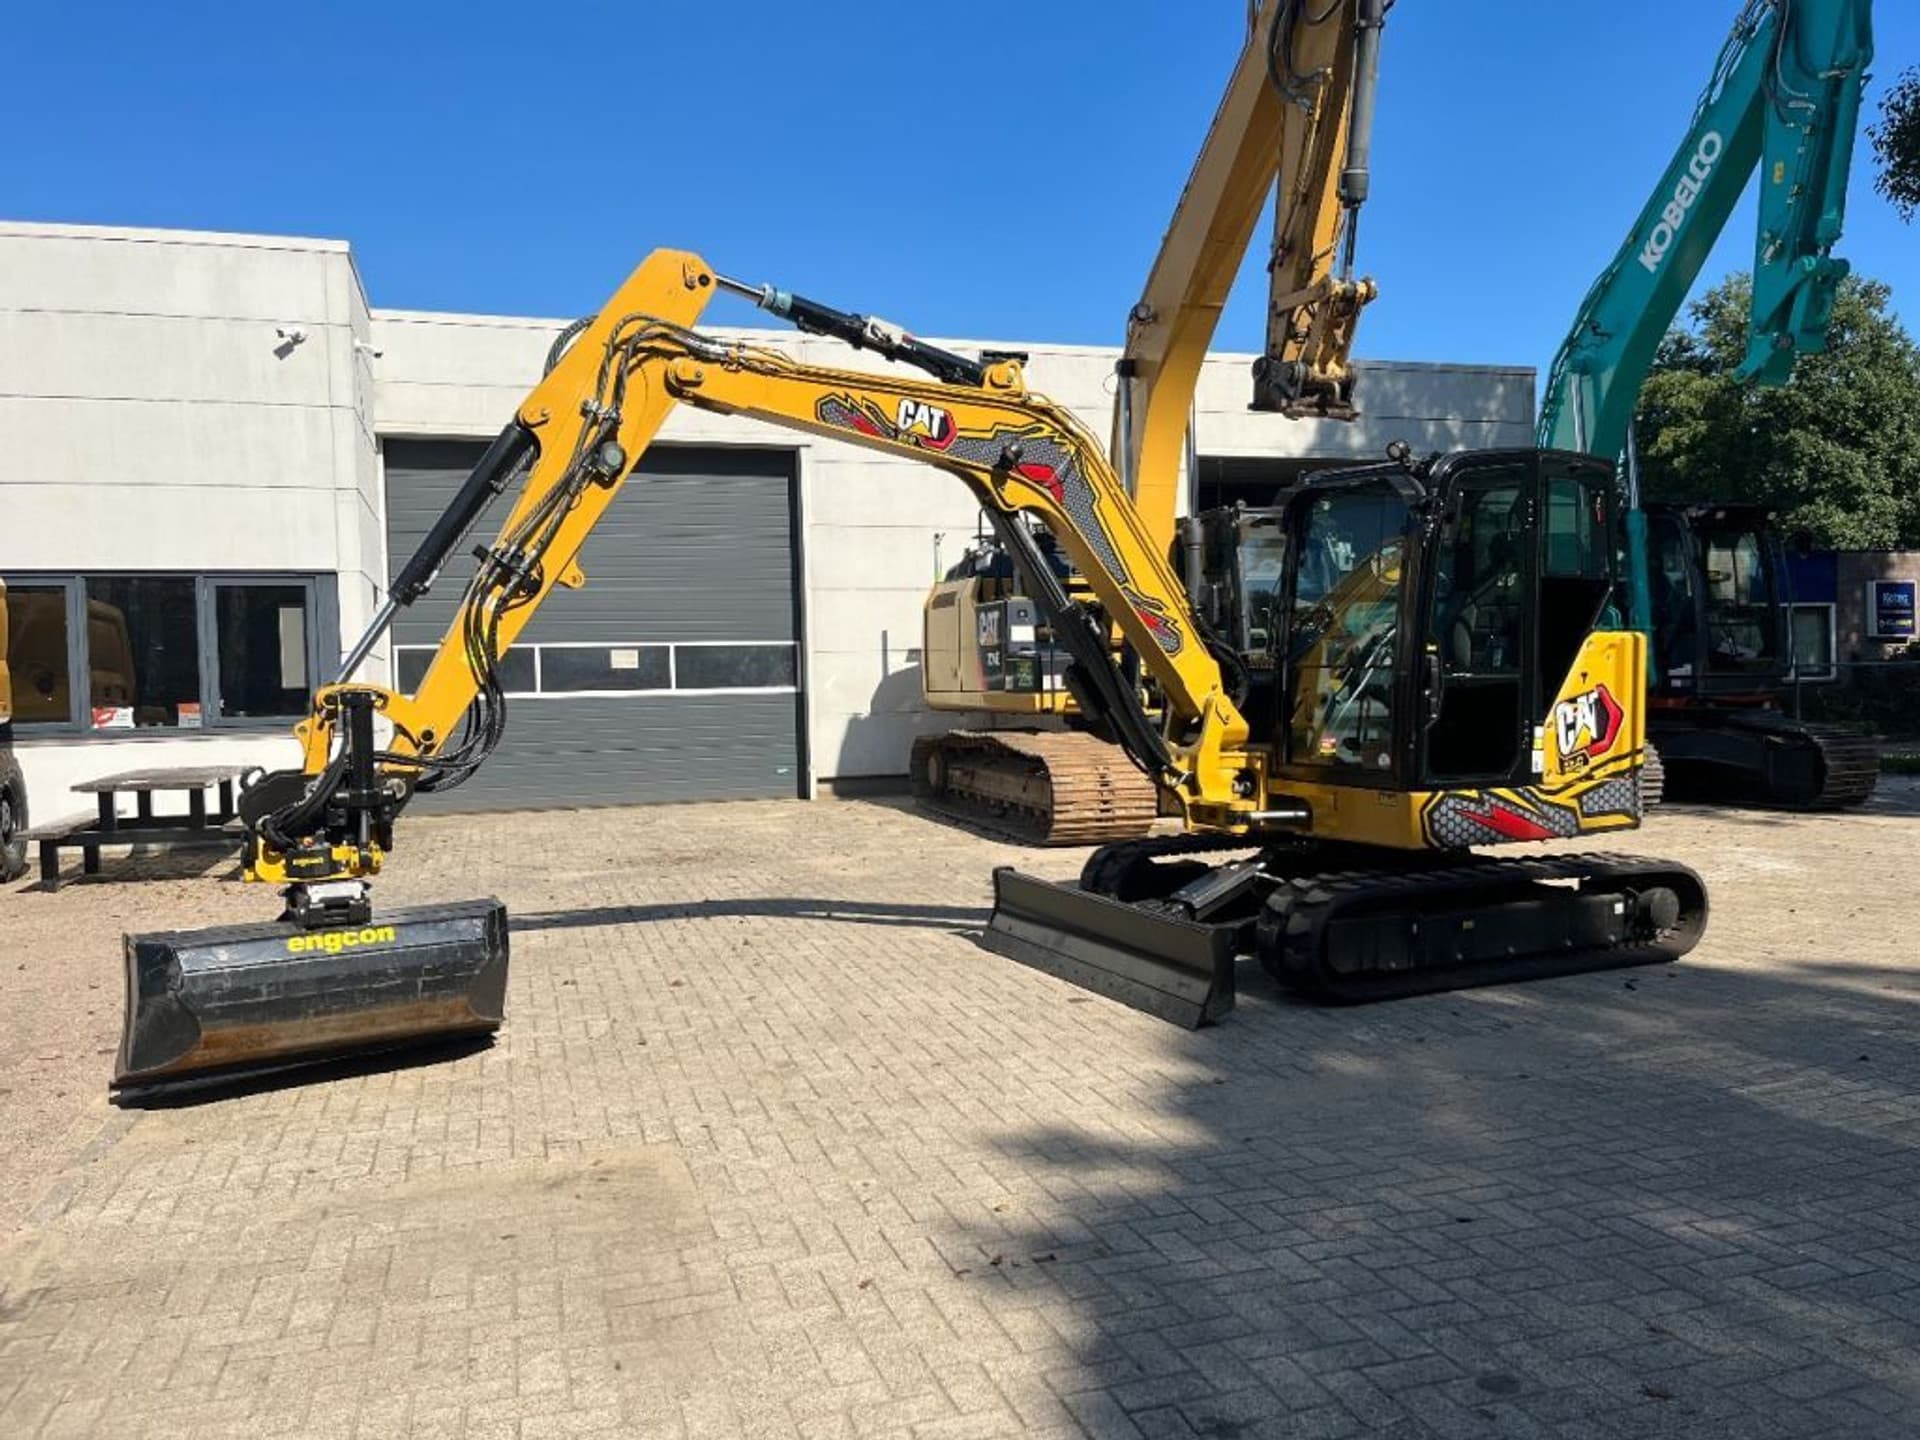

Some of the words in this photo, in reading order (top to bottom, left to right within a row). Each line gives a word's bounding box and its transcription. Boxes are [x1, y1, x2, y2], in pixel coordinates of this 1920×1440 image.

[1638, 131, 1722, 273] KOBELCO
[898, 399, 945, 439] CAT
[1556, 691, 1599, 755] CAT
[287, 926, 396, 954] engcon
